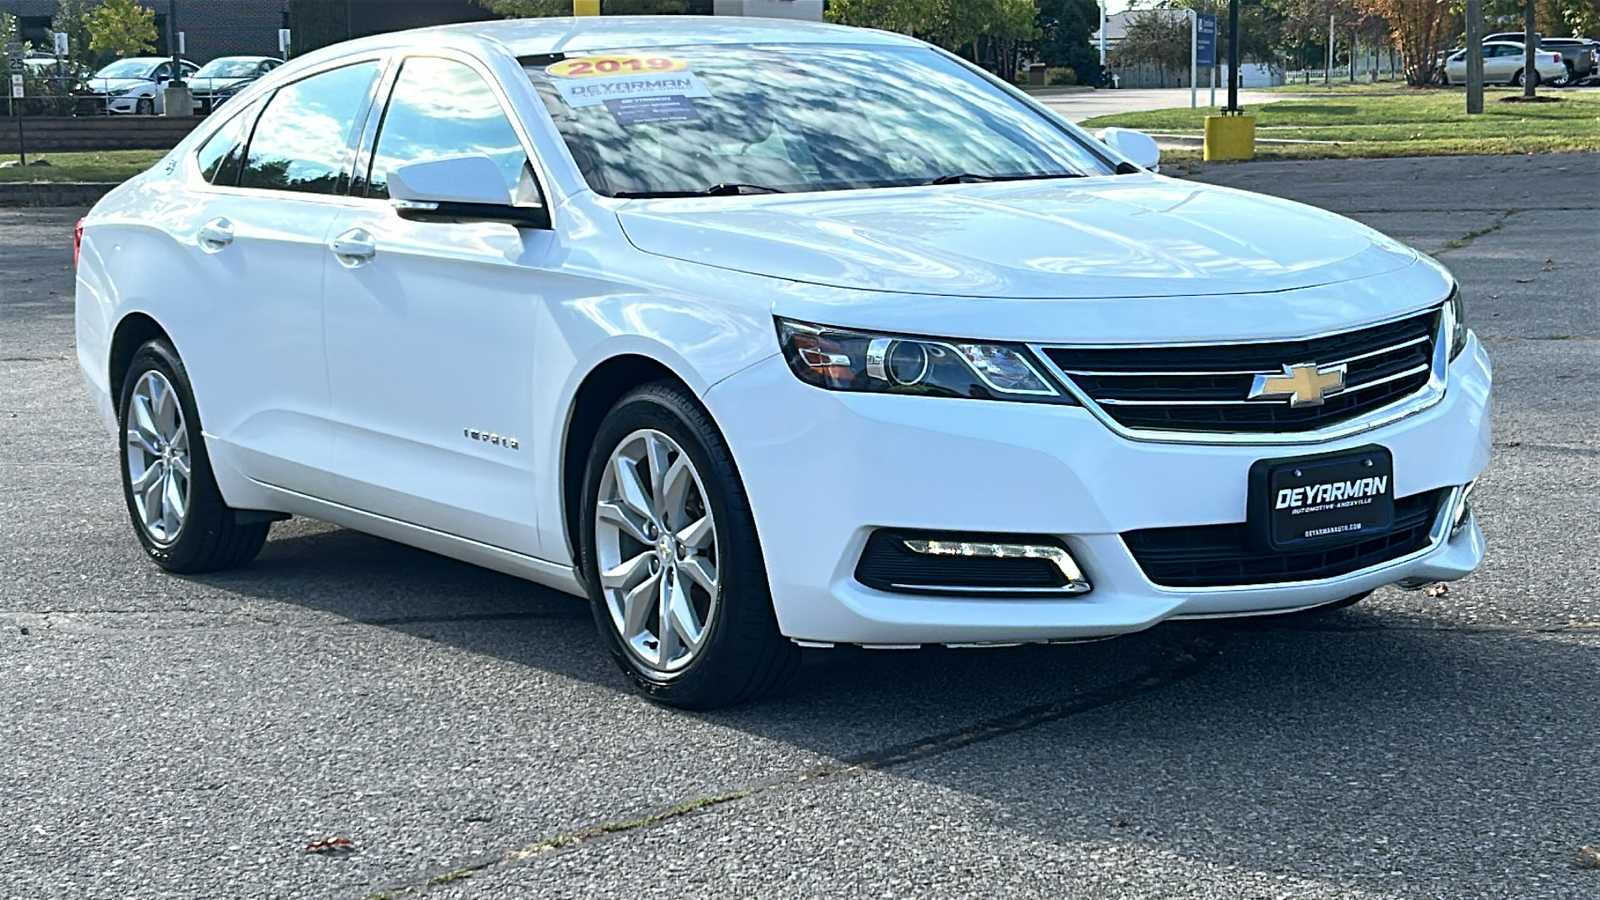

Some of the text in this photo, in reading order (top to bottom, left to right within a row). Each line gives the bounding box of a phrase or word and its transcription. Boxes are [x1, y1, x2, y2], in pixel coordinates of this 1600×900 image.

[10, 58, 23, 69] 25
[568, 58, 672, 75] 2019
[571, 79, 691, 95] DEYARMAN
[1275, 476, 1388, 509] DEYARMAN
[1305, 522, 1362, 537] DEYARMANAUTO.COM
